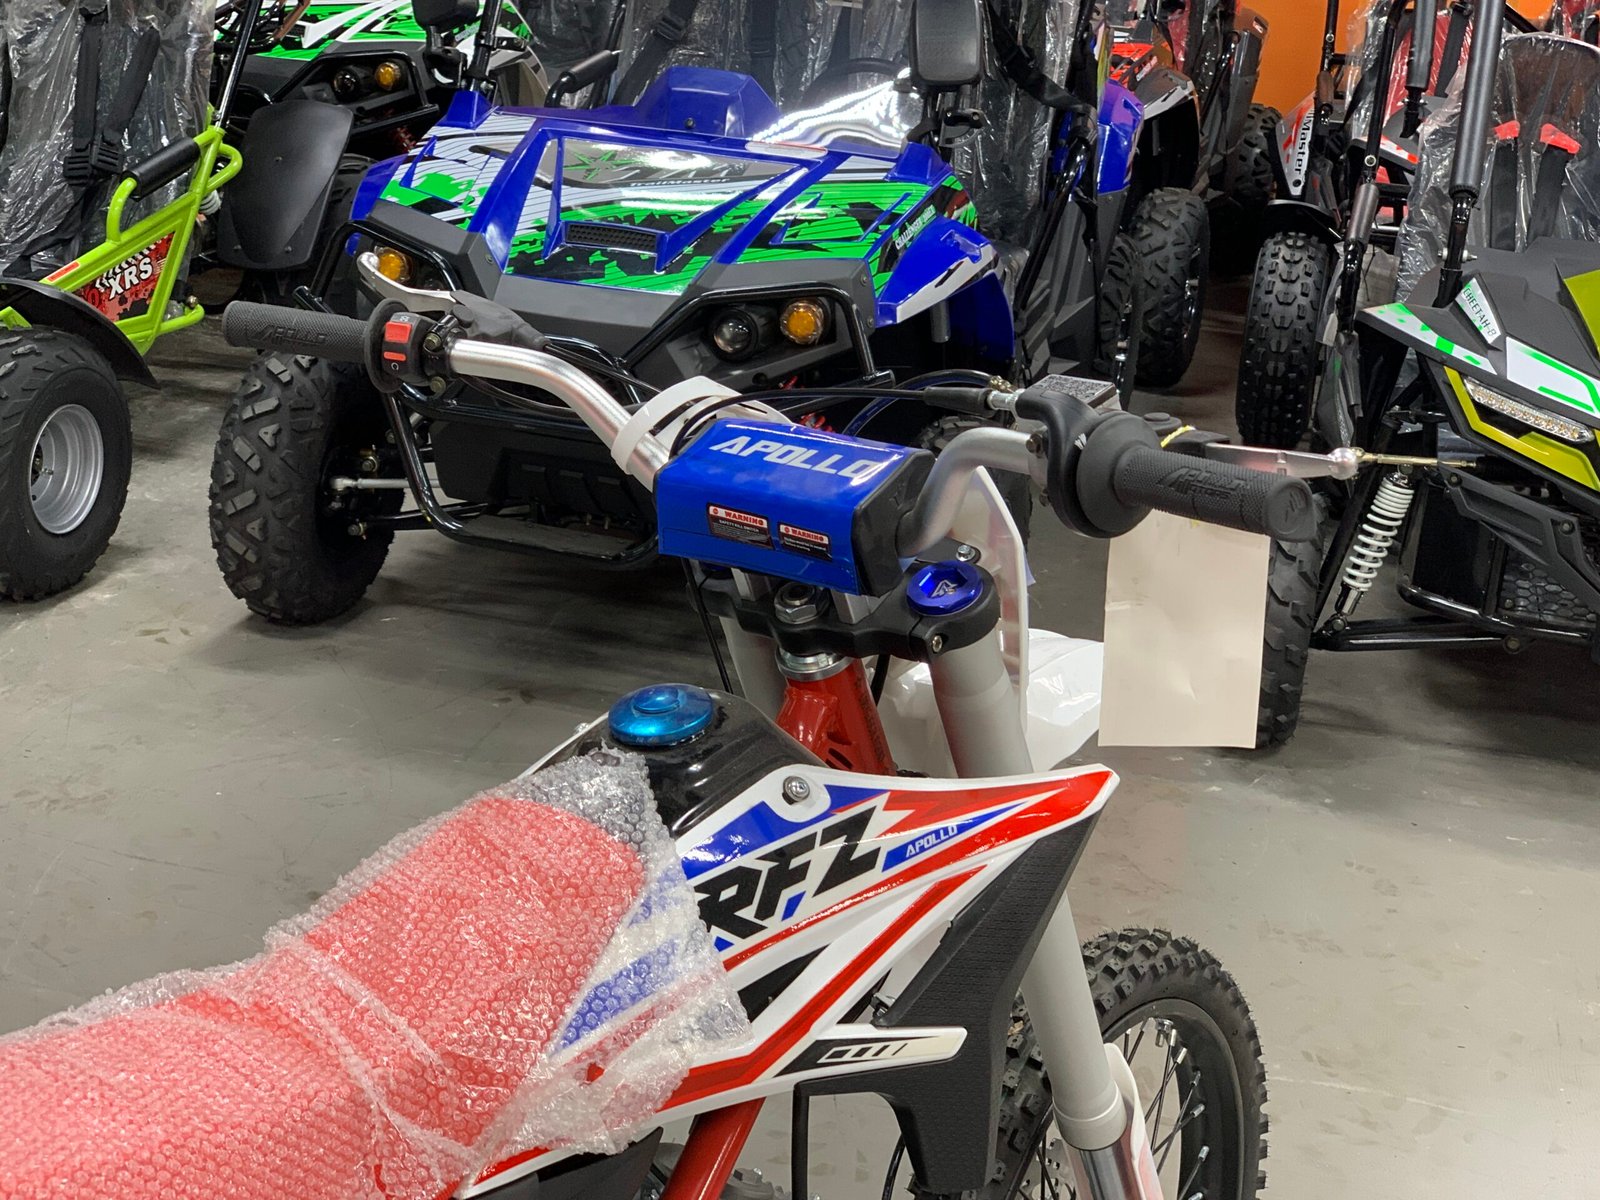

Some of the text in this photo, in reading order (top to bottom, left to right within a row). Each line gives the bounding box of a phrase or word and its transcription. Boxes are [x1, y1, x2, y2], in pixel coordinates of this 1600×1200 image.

[109, 257, 153, 299] XRS
[708, 435, 882, 484] APOLLO
[724, 510, 764, 526] WARNING
[791, 528, 824, 542] WARNING
[905, 824, 958, 858] APOLLO
[693, 805, 882, 940] RFZ
